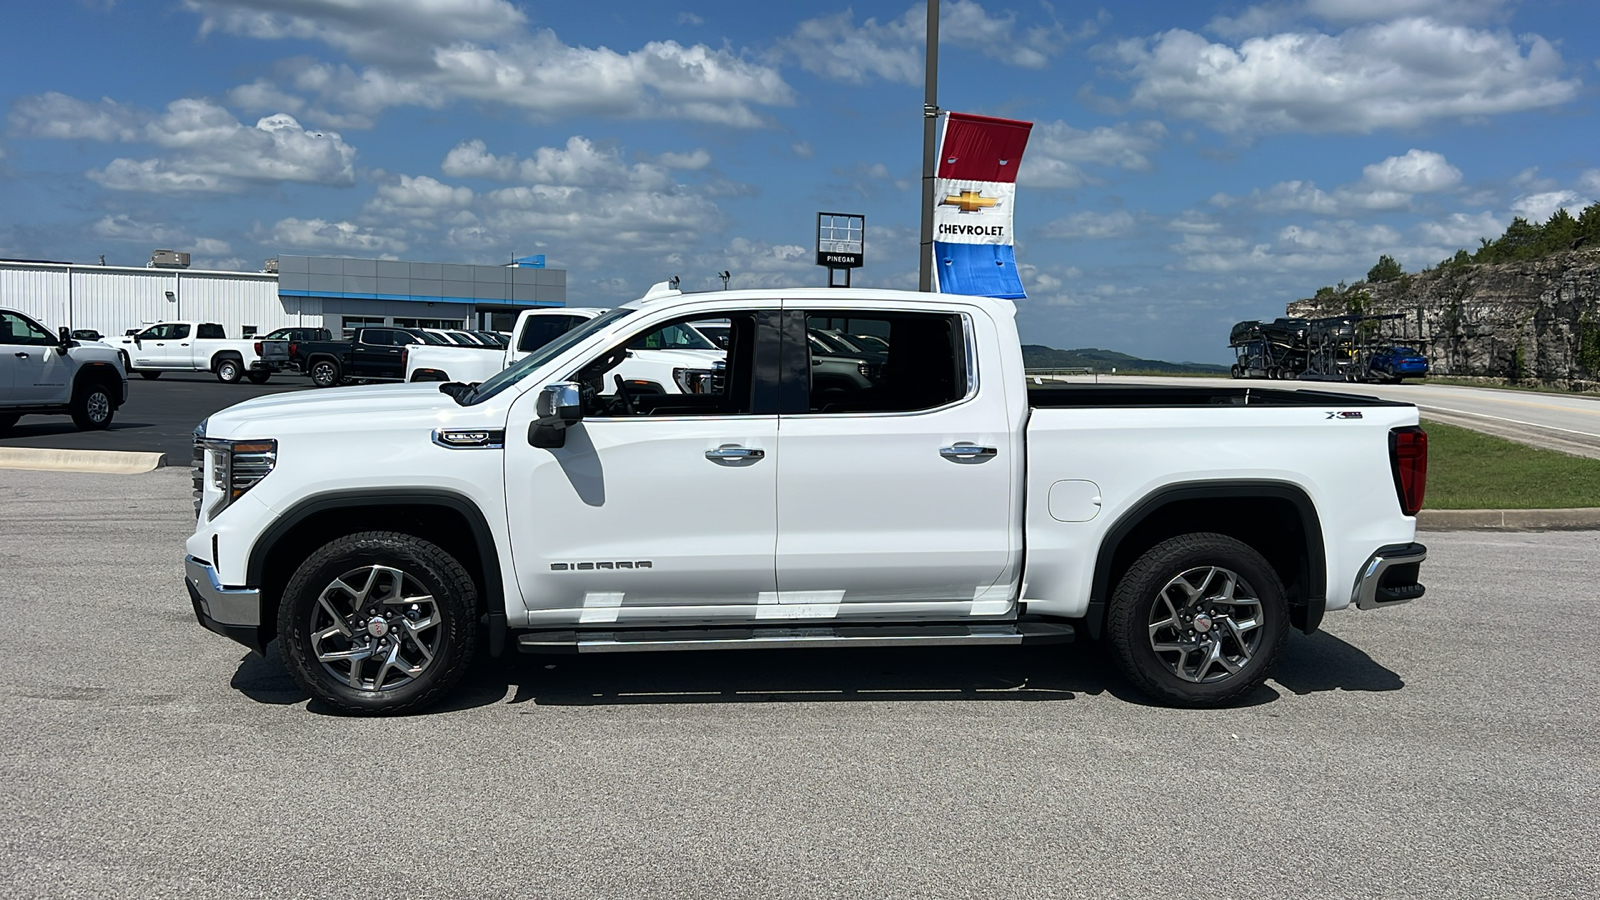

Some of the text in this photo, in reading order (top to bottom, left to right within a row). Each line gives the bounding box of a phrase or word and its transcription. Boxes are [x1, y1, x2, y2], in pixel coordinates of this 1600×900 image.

[938, 223, 1004, 236] CHEVROLET
[826, 255, 855, 263] PINEGAR
[550, 560, 653, 571] SIERRA
